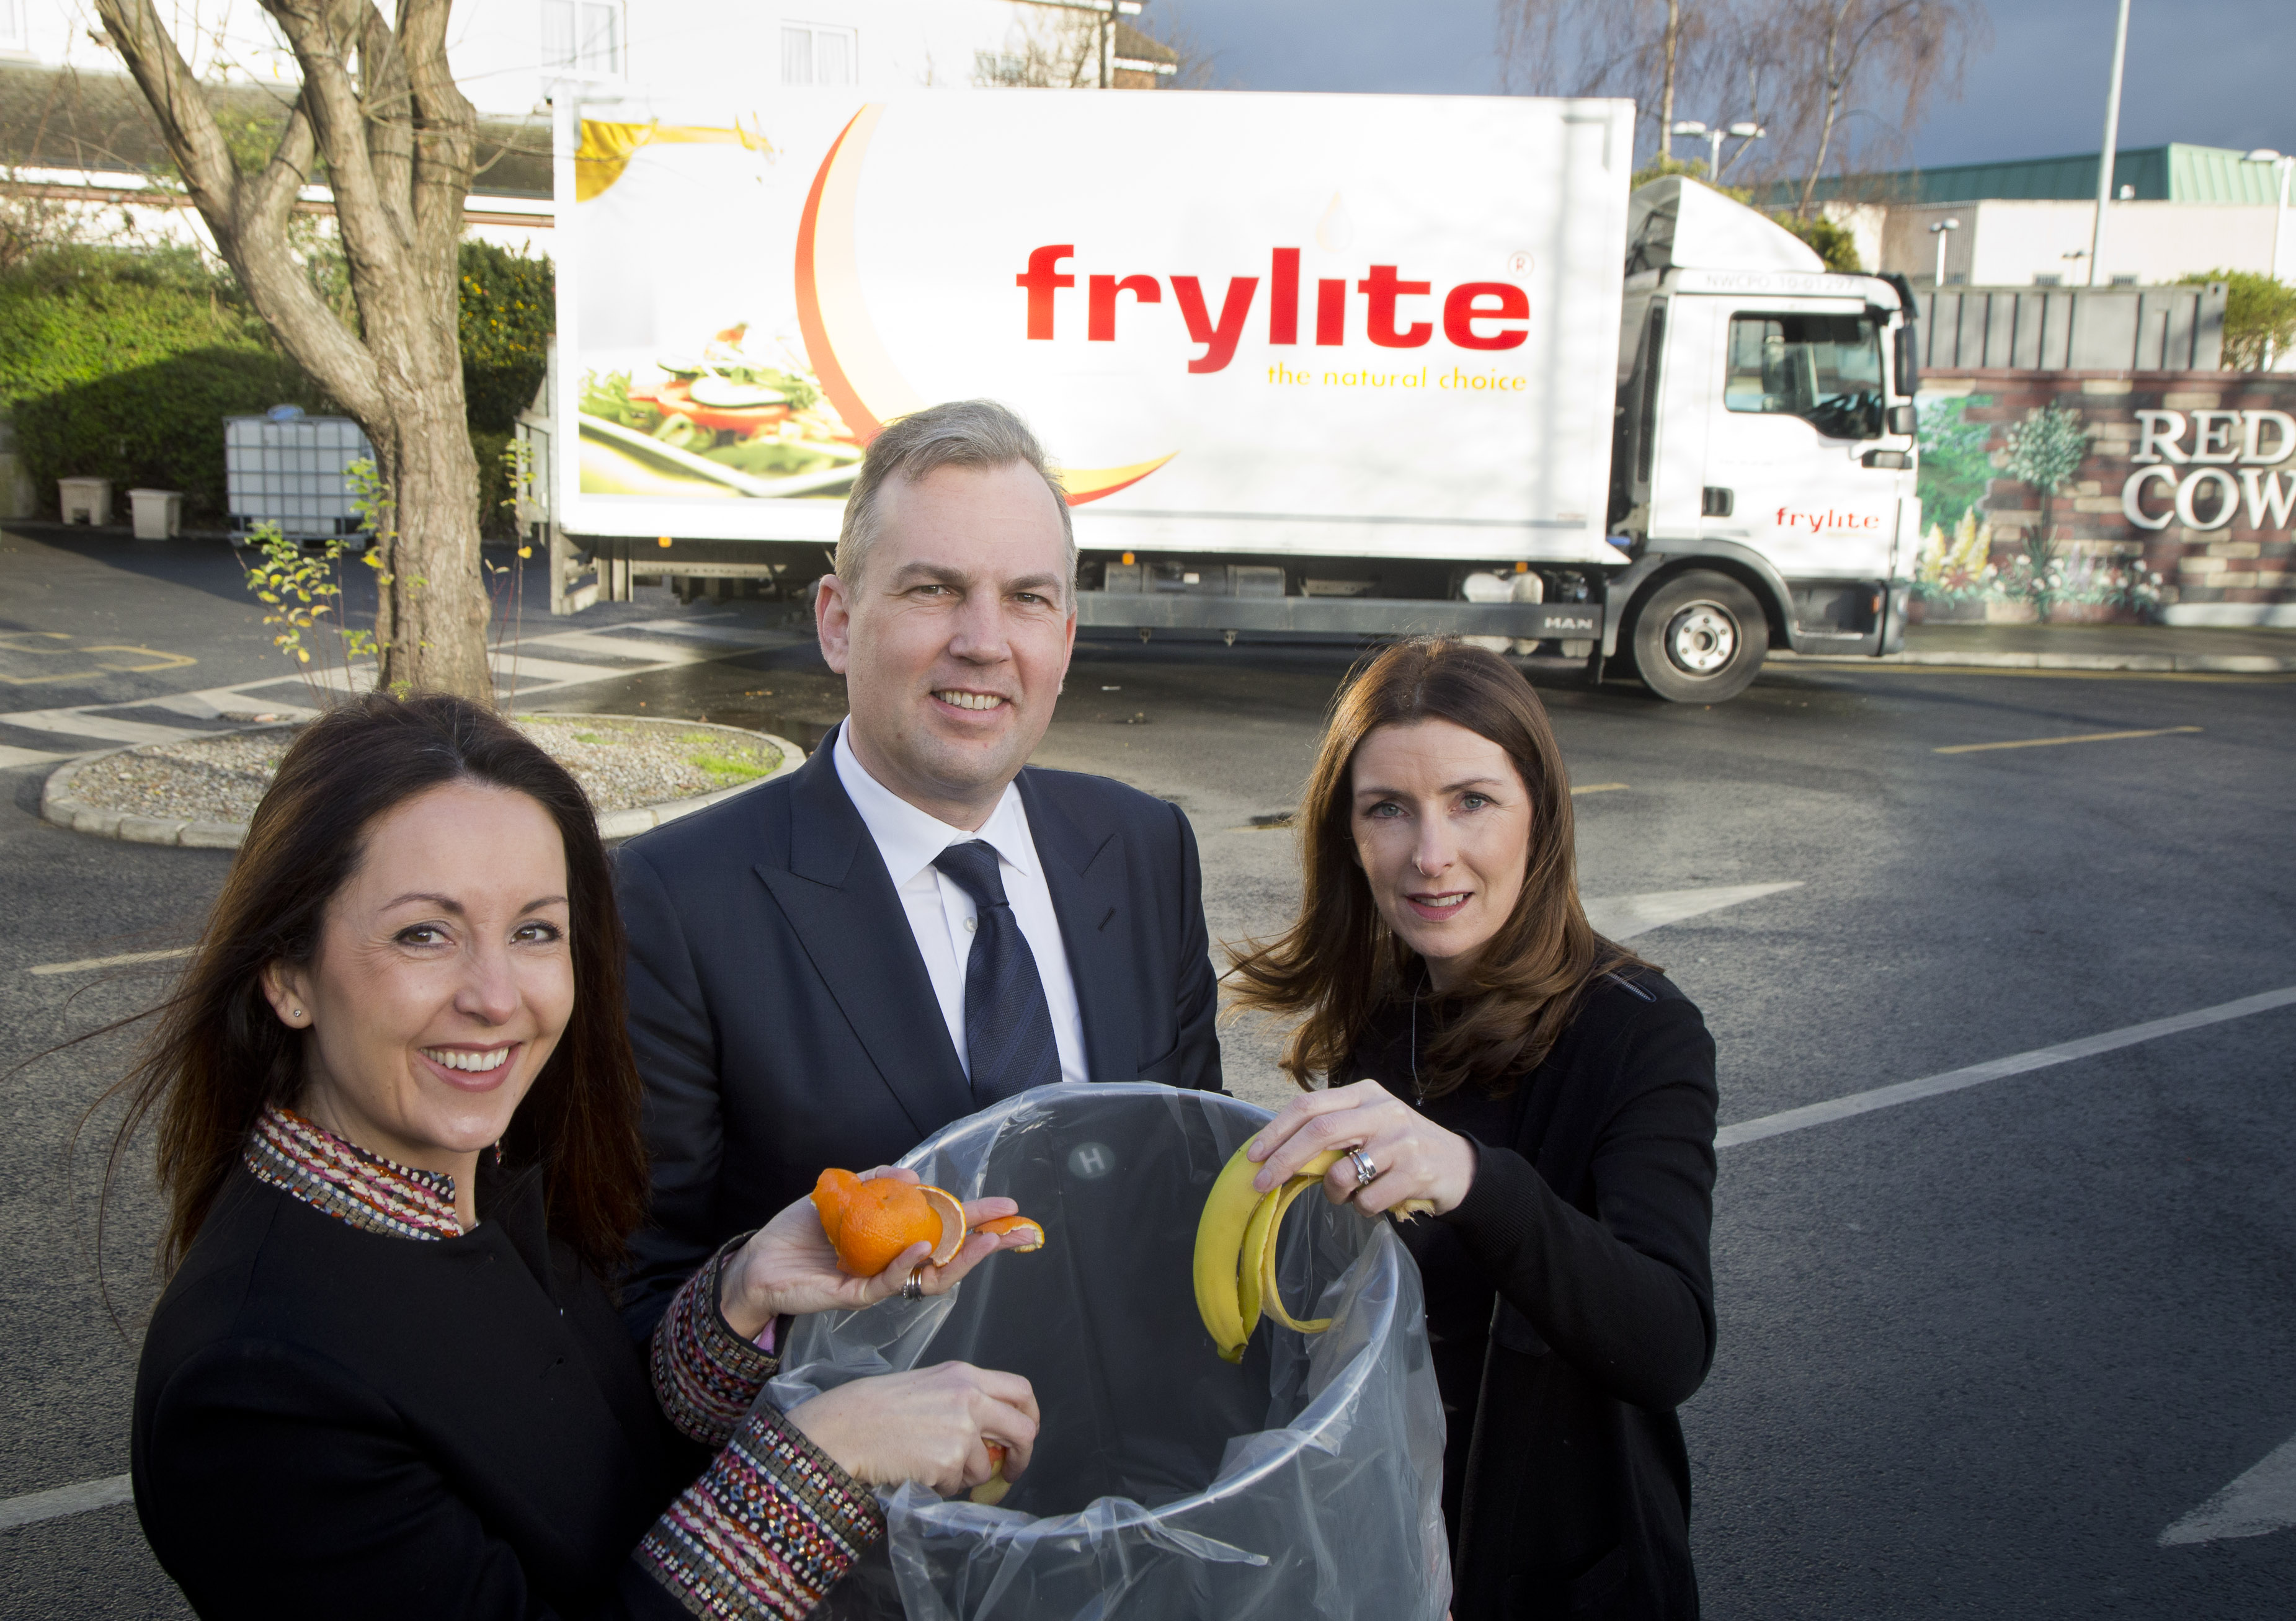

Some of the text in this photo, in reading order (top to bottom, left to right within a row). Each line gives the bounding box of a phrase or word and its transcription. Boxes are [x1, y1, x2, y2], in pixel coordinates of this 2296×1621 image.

[1017, 244, 1530, 374] frylite
[1268, 362, 1527, 392] the natural choice
[2130, 409, 2296, 464] RED
[2122, 464, 2296, 530] COW
[1776, 507, 1879, 533] frylite
[1544, 616, 1593, 629] MAN
[1079, 1147, 1105, 1173] H
